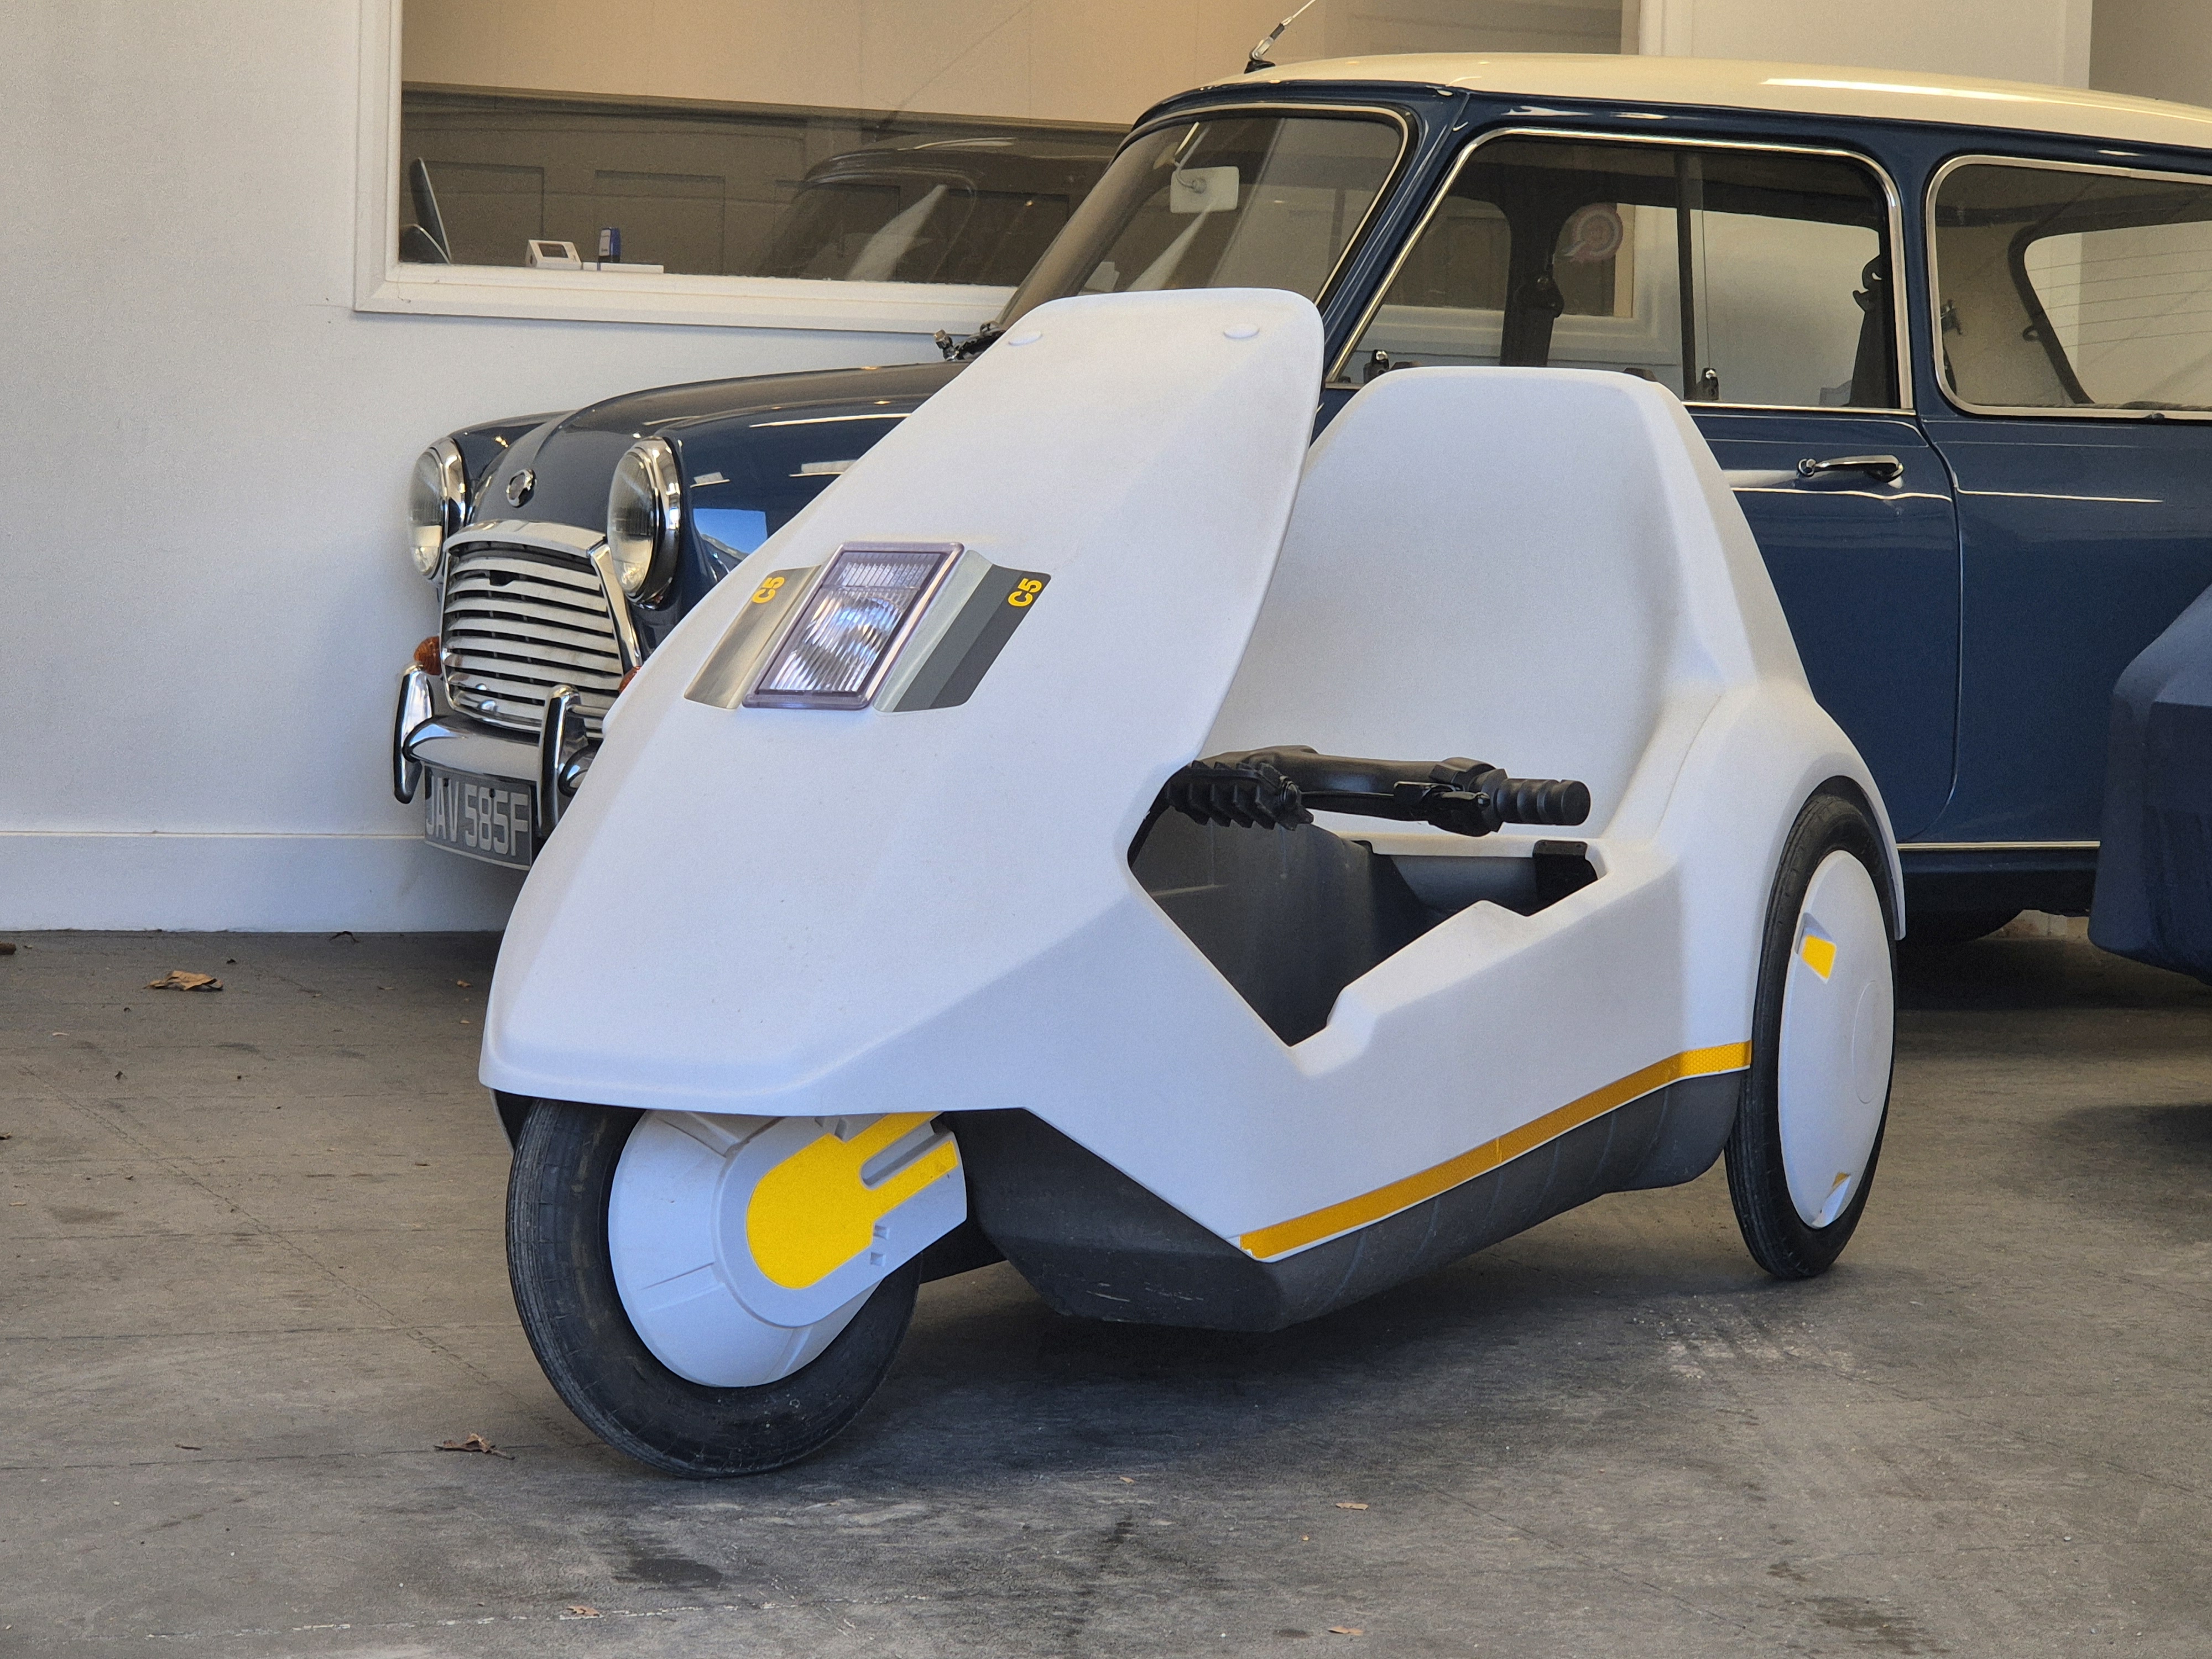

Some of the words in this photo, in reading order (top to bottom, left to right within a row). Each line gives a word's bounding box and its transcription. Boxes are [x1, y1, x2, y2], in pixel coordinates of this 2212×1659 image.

[752, 577, 785, 603] C5
[1008, 578, 1042, 606] C5
[426, 775, 459, 842] JAV
[465, 783, 528, 856] 585F
